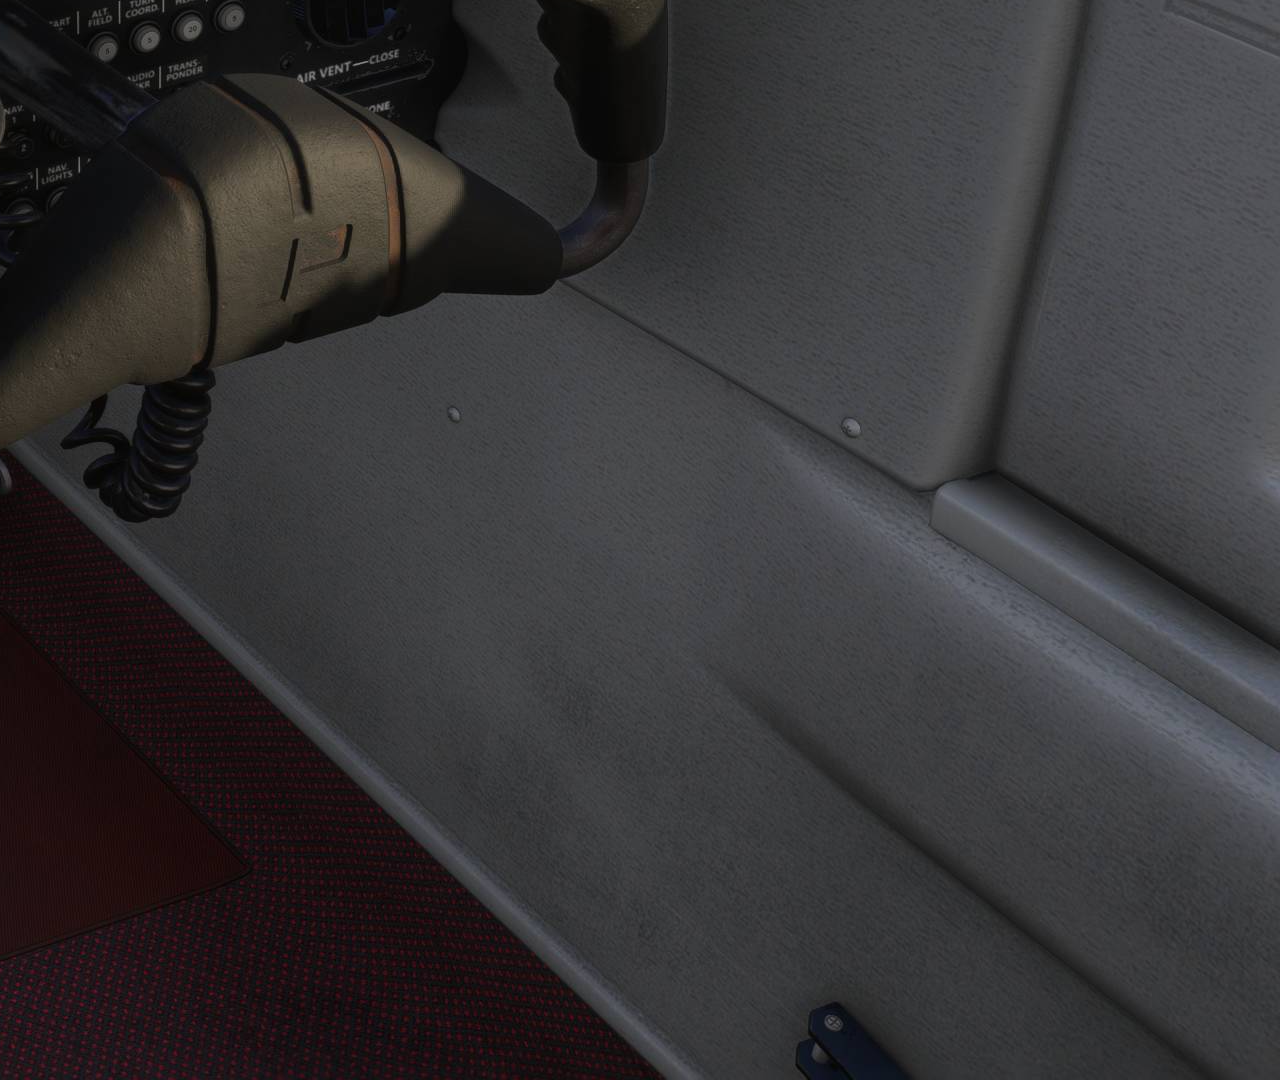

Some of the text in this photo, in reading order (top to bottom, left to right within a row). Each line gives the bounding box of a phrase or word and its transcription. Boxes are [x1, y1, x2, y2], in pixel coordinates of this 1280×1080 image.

[88, 15, 113, 28] FIELD
[166, 65, 203, 82] PONDER
[297, 49, 400, 83] AIR VENT CLOSE
